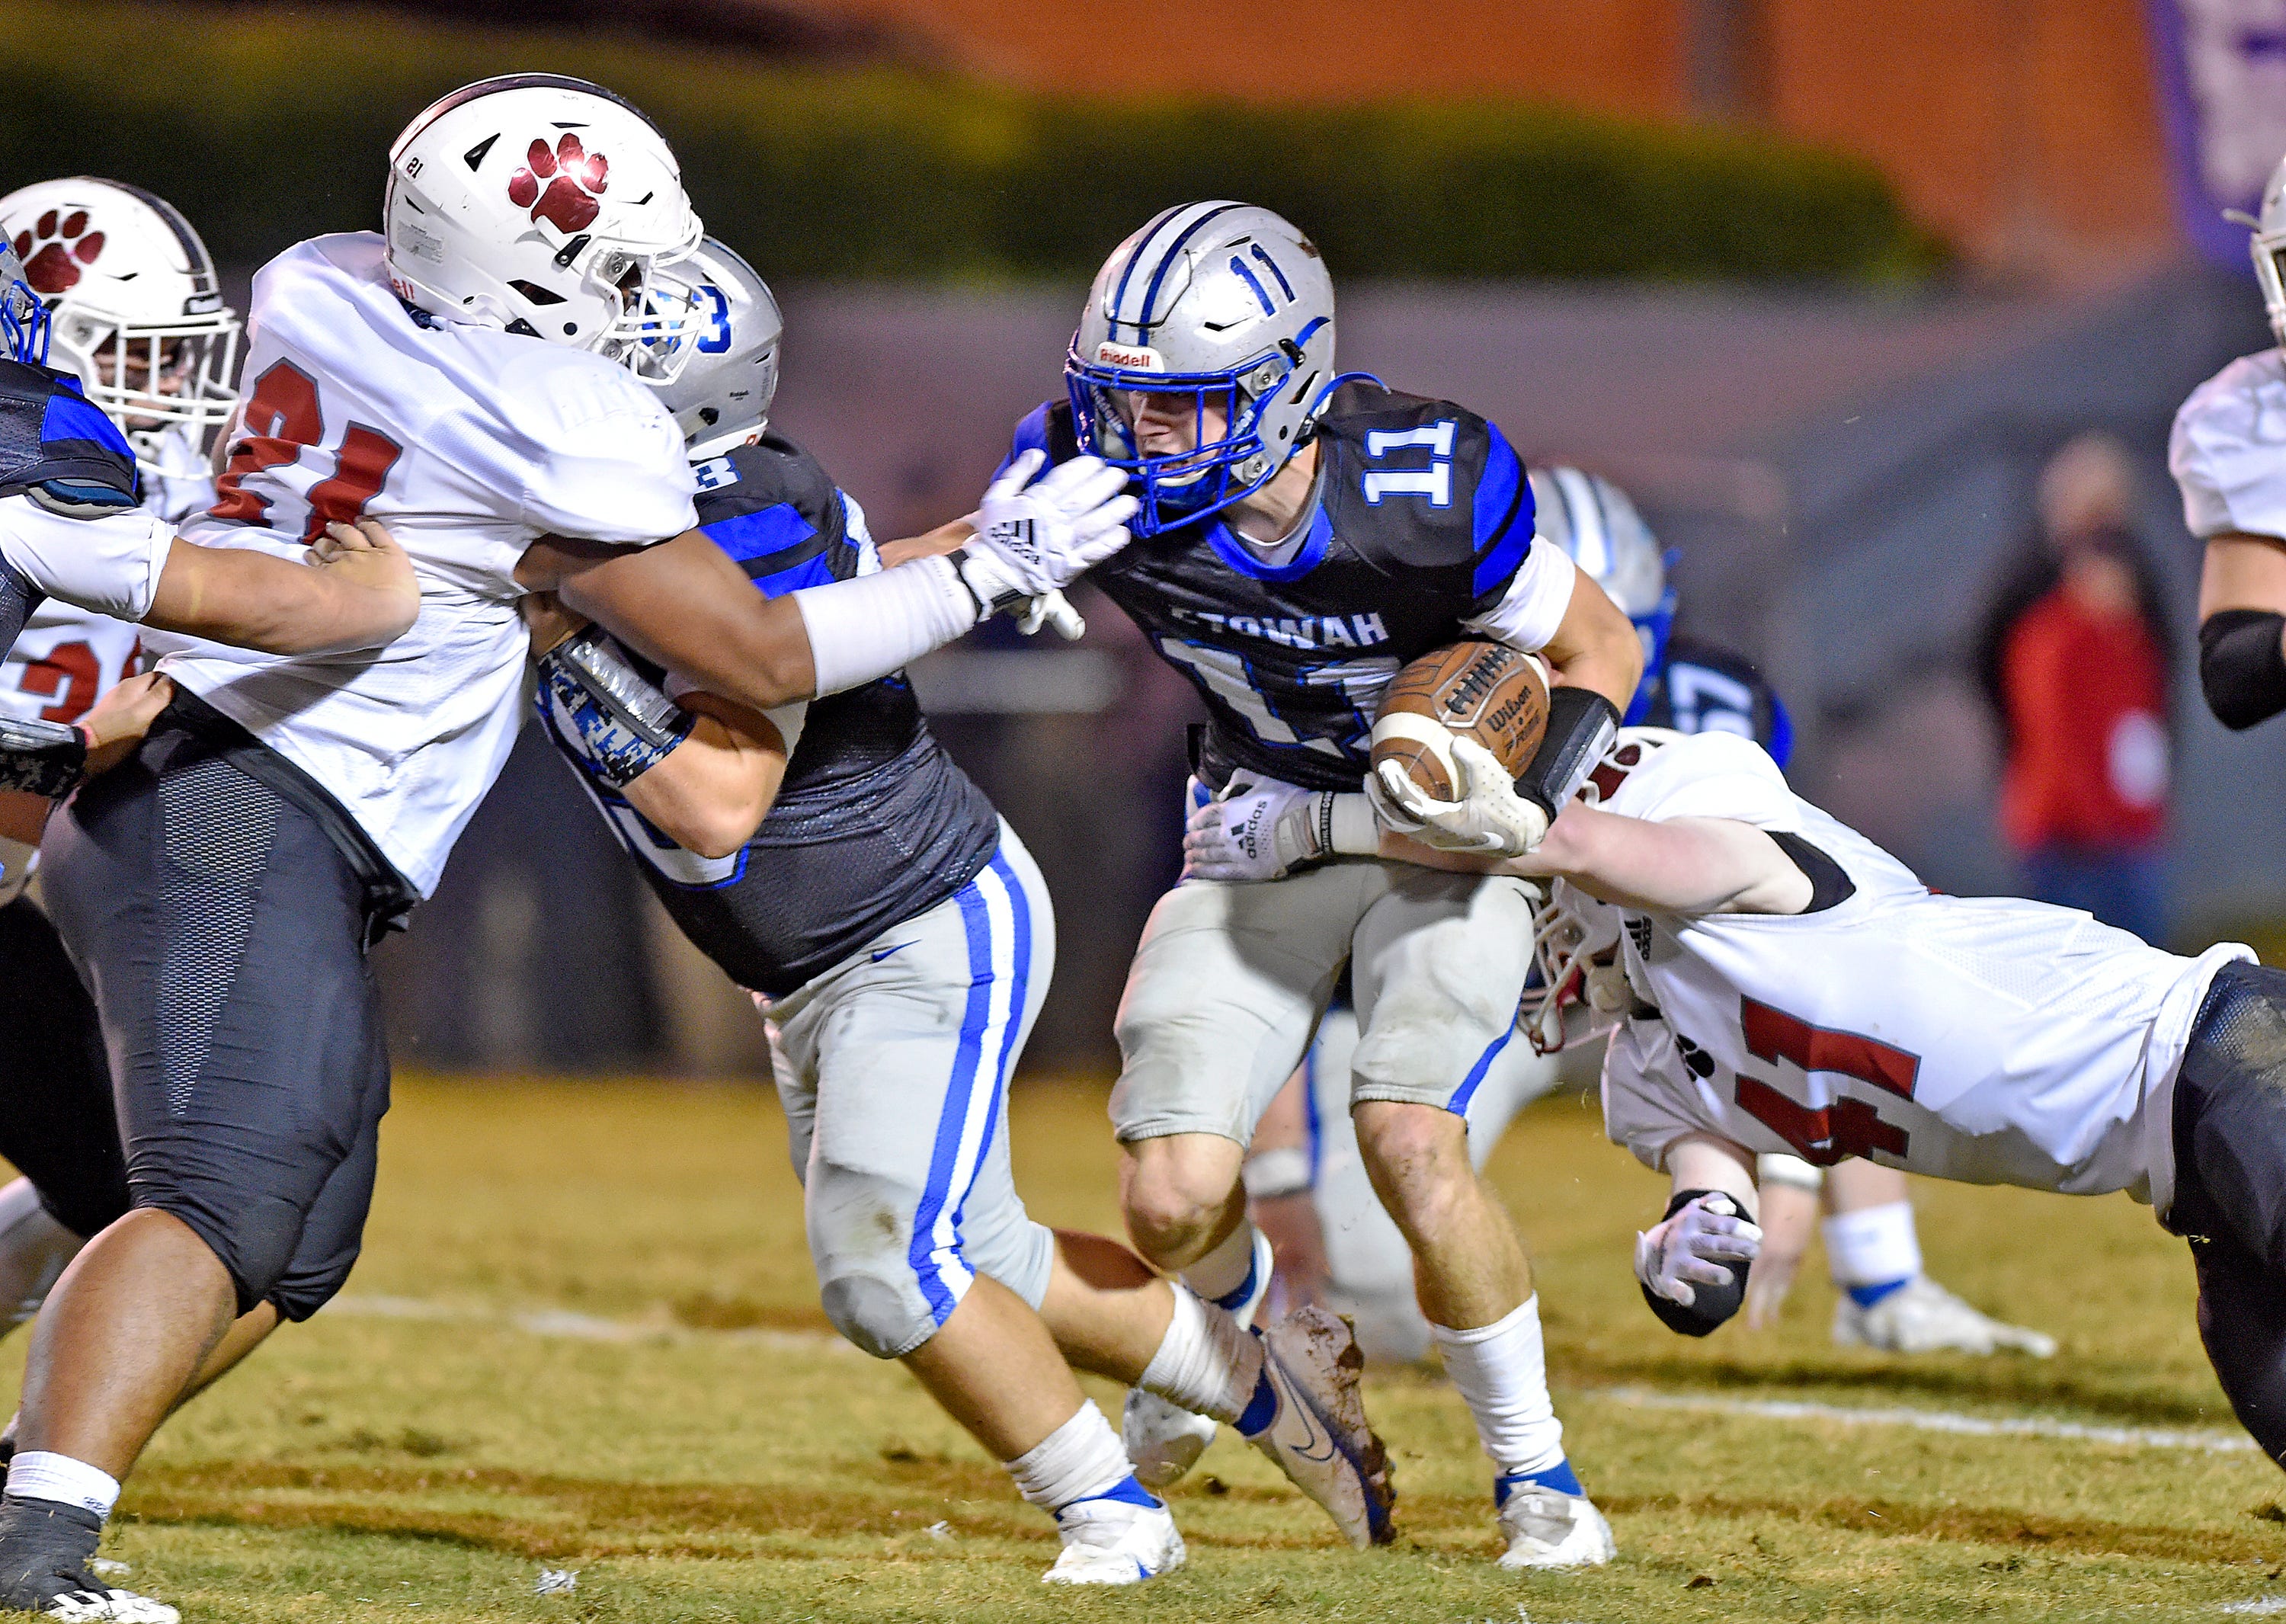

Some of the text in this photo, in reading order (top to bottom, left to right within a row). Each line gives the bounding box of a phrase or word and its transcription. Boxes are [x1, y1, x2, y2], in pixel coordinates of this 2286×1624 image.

[405, 156, 424, 179] 21
[1226, 239, 1298, 321] 11
[208, 355, 403, 546] 21
[1361, 418, 1459, 509] 11
[1485, 685, 1532, 732] Wilson
[1245, 800, 1268, 859] adidas
[1734, 992, 1922, 1168] 41
